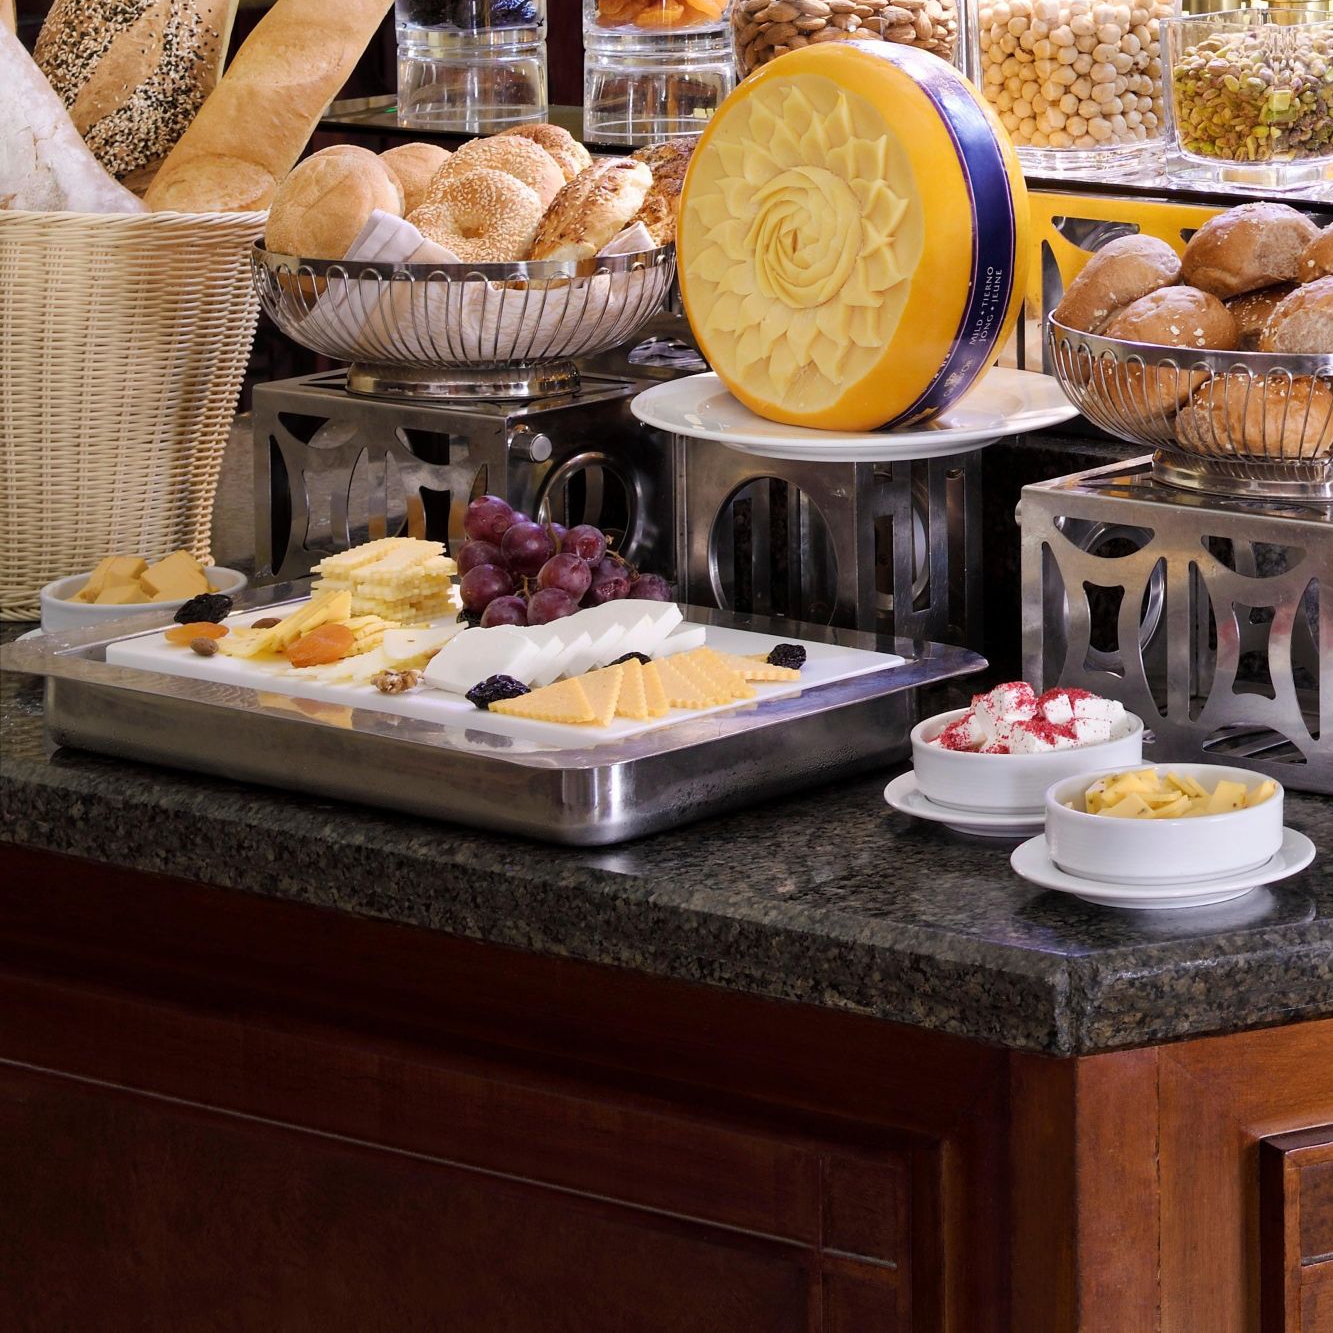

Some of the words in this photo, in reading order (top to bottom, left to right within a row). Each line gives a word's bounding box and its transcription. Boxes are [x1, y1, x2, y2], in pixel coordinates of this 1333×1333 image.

[968, 319, 983, 345] MILD
[981, 266, 994, 307] TIERNO
[979, 314, 994, 342] JONG
[991, 269, 1003, 302] JEUNE
